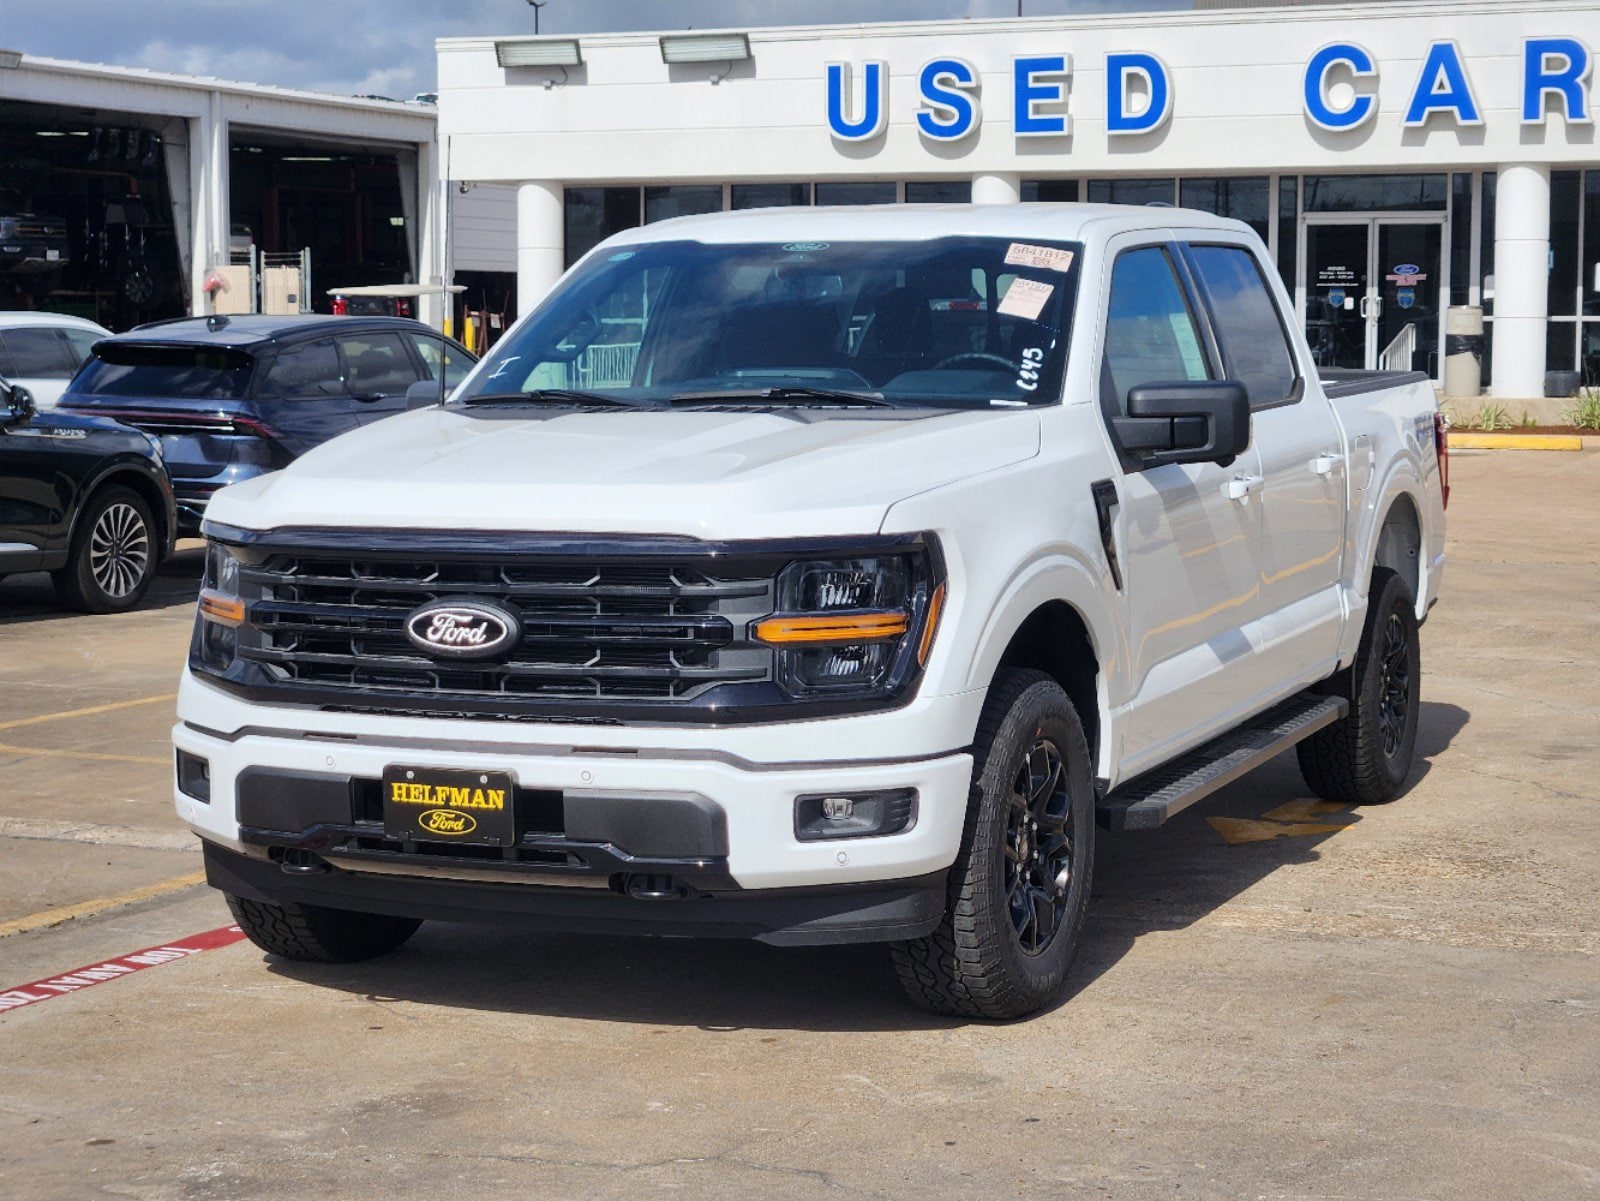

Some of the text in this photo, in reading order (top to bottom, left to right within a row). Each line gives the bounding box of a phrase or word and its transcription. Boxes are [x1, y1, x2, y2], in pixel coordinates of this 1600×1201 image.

[825, 36, 1593, 142] USED CAR
[424, 612, 490, 645] Ford
[391, 782, 505, 809] HELFMAN
[427, 810, 467, 832] Ford
